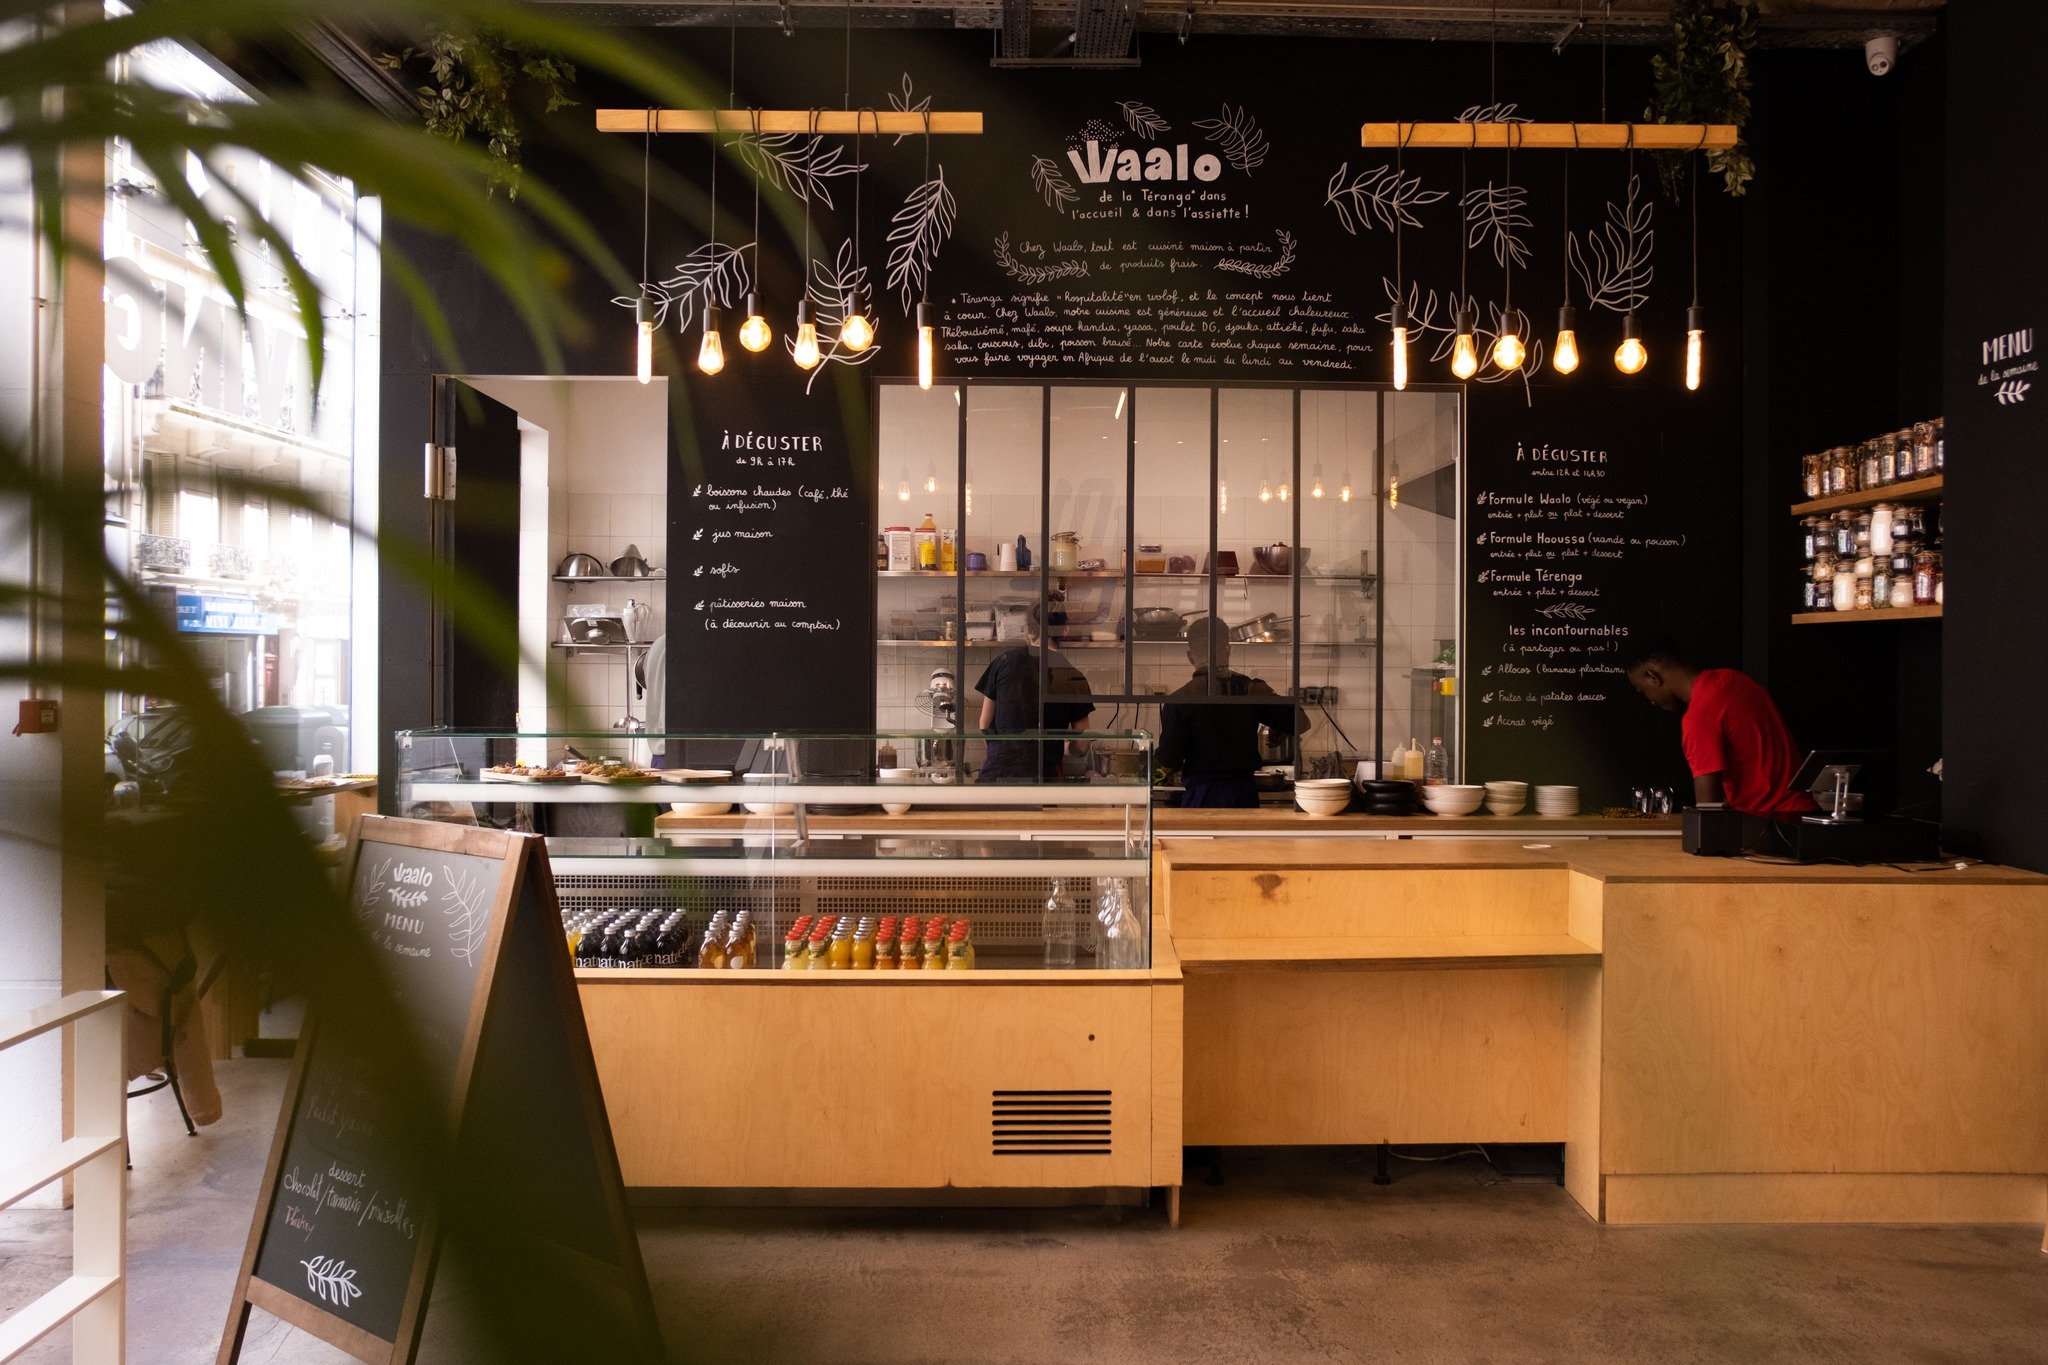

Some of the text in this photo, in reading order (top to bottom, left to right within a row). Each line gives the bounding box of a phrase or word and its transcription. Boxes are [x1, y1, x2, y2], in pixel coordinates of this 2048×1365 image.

[1066, 140, 1222, 184] Waalo
[1099, 190, 1112, 203] de
[1122, 190, 1132, 201] la
[1200, 190, 1226, 201] dans
[1072, 206, 1240, 220] l'accueil & dans l'assiette
[1019, 238, 1273, 260] Chez Waalo, tout est cuisiné maison à partir
[1099, 261, 1112, 270] de
[1119, 258, 1165, 273] produits
[960, 292, 1003, 308] Téranga
[1010, 292, 1050, 307] signifie
[1189, 291, 1200, 301] et
[1206, 289, 1218, 300] le
[1225, 290, 1264, 305] concept
[1302, 290, 1332, 303] tient
[944, 311, 951, 321] à
[957, 312, 990, 320] coeur.
[995, 307, 1019, 323] Chez
[1024, 306, 1057, 317] Waalo,
[1063, 307, 1090, 316] notre
[1095, 307, 1131, 316] cuisine
[1137, 306, 1153, 316] est
[1158, 307, 1208, 321] généreuse
[1213, 306, 1224, 317] et
[1231, 305, 1281, 317] l'accueil
[1011, 323, 1040, 336] mafé,
[1044, 324, 1074, 336] soupe
[1077, 320, 1120, 332] kandia,
[1123, 324, 1157, 337] yassa,
[1161, 320, 1196, 335] poulet
[1202, 321, 1220, 333] DG,
[1225, 321, 1263, 335] djouka,
[1311, 323, 1337, 337] fufu,
[1342, 323, 1366, 334] saka
[944, 340, 972, 351] saka,
[977, 340, 1024, 349] couscous,
[1028, 337, 1054, 349] dibi,
[1059, 339, 1097, 351] poisson
[1146, 337, 1171, 347] Notre
[1178, 339, 1203, 349] carte
[1211, 338, 1243, 349] évolue
[1247, 339, 1282, 353] chaque
[1288, 341, 1341, 352] semaine,
[1346, 344, 1373, 354] pour
[1982, 327, 2033, 365] MENU
[954, 356, 979, 364] vous
[984, 352, 1011, 366] faire
[1017, 354, 1059, 368] voyager
[1078, 352, 1115, 366] Afrique
[1119, 352, 1133, 363] de
[1138, 352, 1174, 363] l'ouest
[1181, 352, 1191, 364] le
[1193, 355, 1217, 364] midi
[1223, 355, 1236, 365] du
[1241, 353, 1272, 366] lundi
[1978, 359, 2039, 385] de la semaine
[721, 430, 823, 452] À DÉGUSTER
[1516, 441, 1608, 464] À DÉGUSTER
[750, 456, 763, 466] 9h
[767, 457, 774, 466] à
[778, 457, 796, 466] 17h
[1531, 468, 1555, 476] entre
[1572, 469, 1580, 477] et
[1583, 470, 1605, 478] 14h30
[706, 484, 848, 503] boissons chaudes (café, thé
[1489, 492, 1533, 505] Formule
[1540, 493, 1571, 504] Waalo
[1577, 492, 1601, 509] (végé
[725, 499, 777, 514] infusion)
[1487, 508, 1624, 522] entrée plat ou plat dessert
[712, 528, 773, 543] jus maison
[1490, 531, 1532, 544] Formule
[1537, 532, 1585, 544] Haoussa
[1588, 532, 1625, 545] (viande
[1490, 548, 1623, 560] entrée plat ou plat dessert
[710, 563, 740, 578] softs
[1491, 568, 1582, 588] Formule Térenga
[1493, 586, 1600, 599] entrée plat dessert
[709, 598, 807, 612] pâtisseries maison
[705, 618, 718, 630] (à
[722, 618, 771, 629] découvrir
[1509, 624, 1628, 636] les incontournables
[1503, 643, 1515, 652] (à
[1519, 643, 1565, 658] partager
[1498, 663, 1576, 674] Allocos (bananes
[1498, 690, 1606, 706] Frites de patates douces
[1496, 714, 1554, 731] Accras végé
[393, 863, 433, 887] Waalo
[384, 912, 425, 934] MENU
[328, 1161, 367, 1188] dessert
